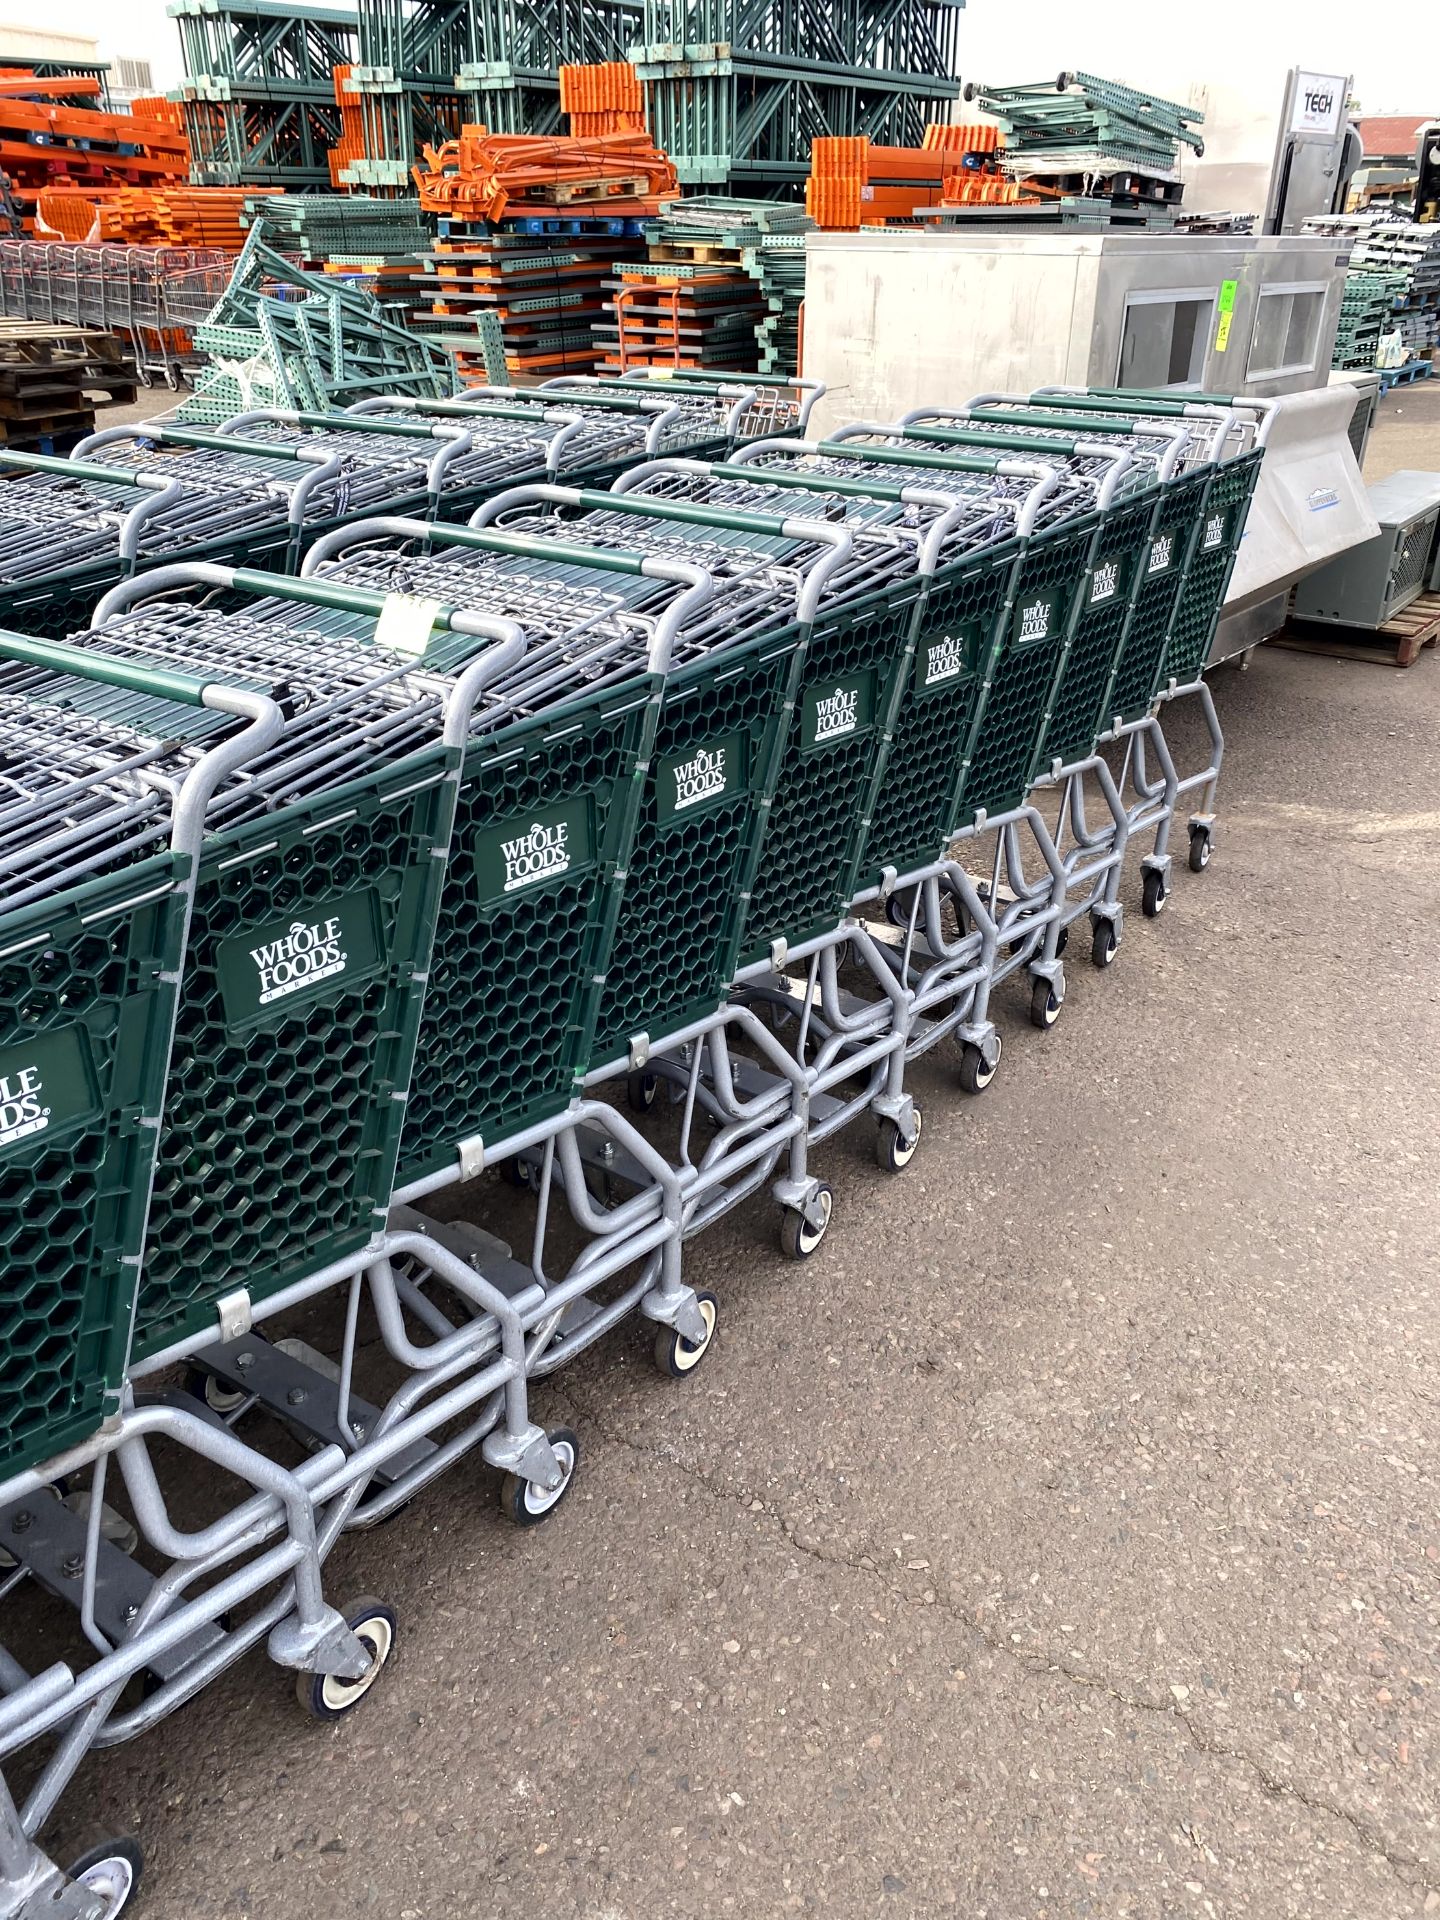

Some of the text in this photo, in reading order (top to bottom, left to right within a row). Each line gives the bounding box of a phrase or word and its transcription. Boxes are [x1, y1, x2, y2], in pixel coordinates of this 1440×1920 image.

[1305, 92, 1333, 114] TECH
[1094, 562, 1118, 584] WHOLE
[1023, 600, 1051, 622] WHOLE
[928, 636, 963, 662] WHOLE
[816, 688, 858, 717] WHOLE
[673, 748, 726, 784] WHOLE
[500, 822, 569, 861] WHOLE
[249, 916, 342, 970] WHOLE
[265, 964, 340, 1000] MARKET
